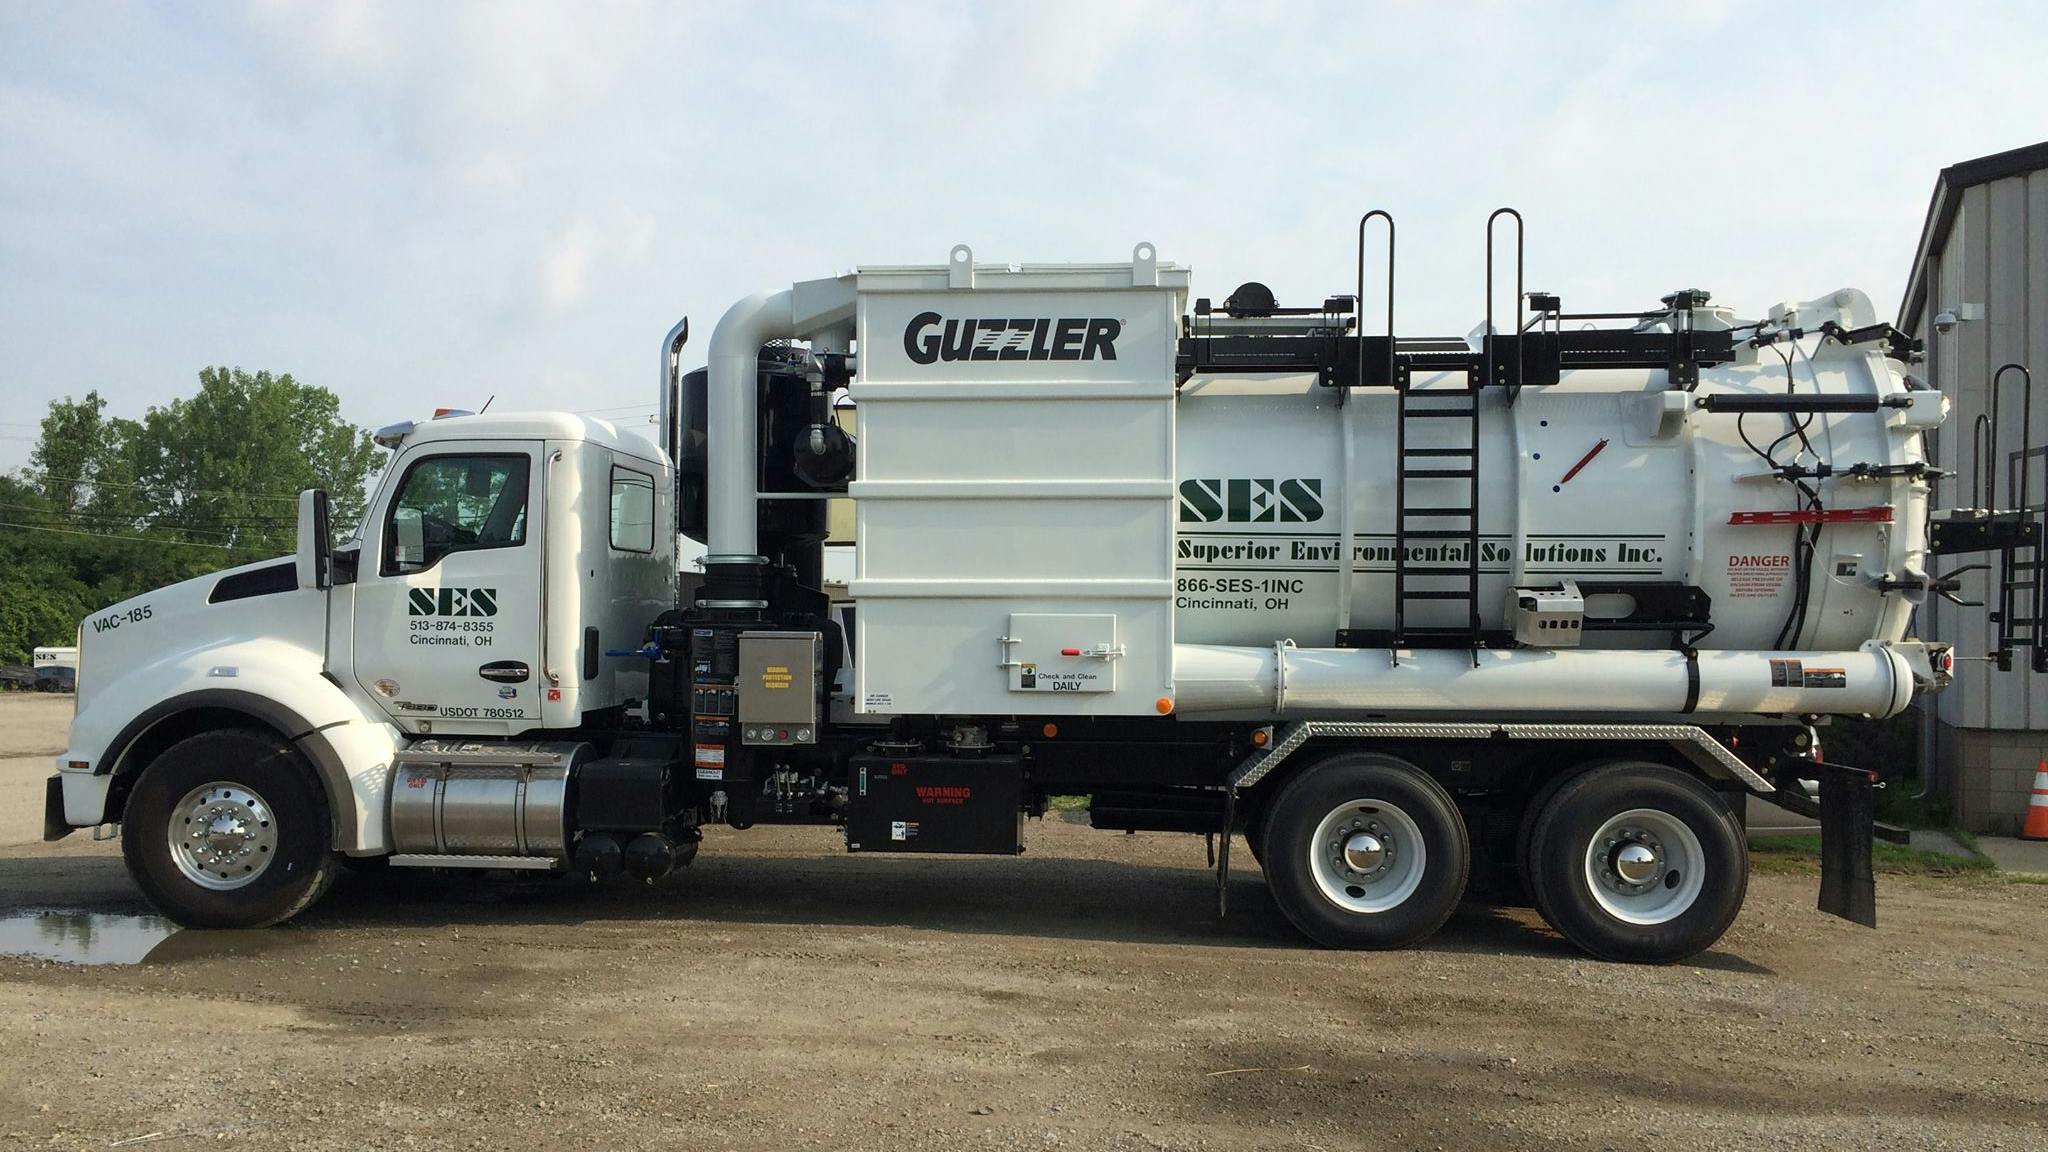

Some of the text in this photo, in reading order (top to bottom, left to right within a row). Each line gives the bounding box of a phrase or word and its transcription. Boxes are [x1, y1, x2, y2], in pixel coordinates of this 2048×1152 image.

[904, 311, 1121, 365] GUZZLER
[1179, 479, 1324, 522] SES
[1178, 539, 1280, 563] Superior
[1618, 542, 1663, 563] Inc.
[1729, 555, 1790, 567] DANGER
[1177, 578, 1304, 594] 866-SES-1INC
[409, 588, 498, 617] SES
[1176, 597, 1289, 611] Cincinnati, OH
[93, 605, 153, 633] VAC-185
[410, 621, 494, 632] 513-874-8355
[410, 634, 492, 647] Cincinnati, OH
[1053, 681, 1081, 690] DAILY
[440, 707, 524, 718] USDOT 780512
[916, 786, 971, 798] WARNING
